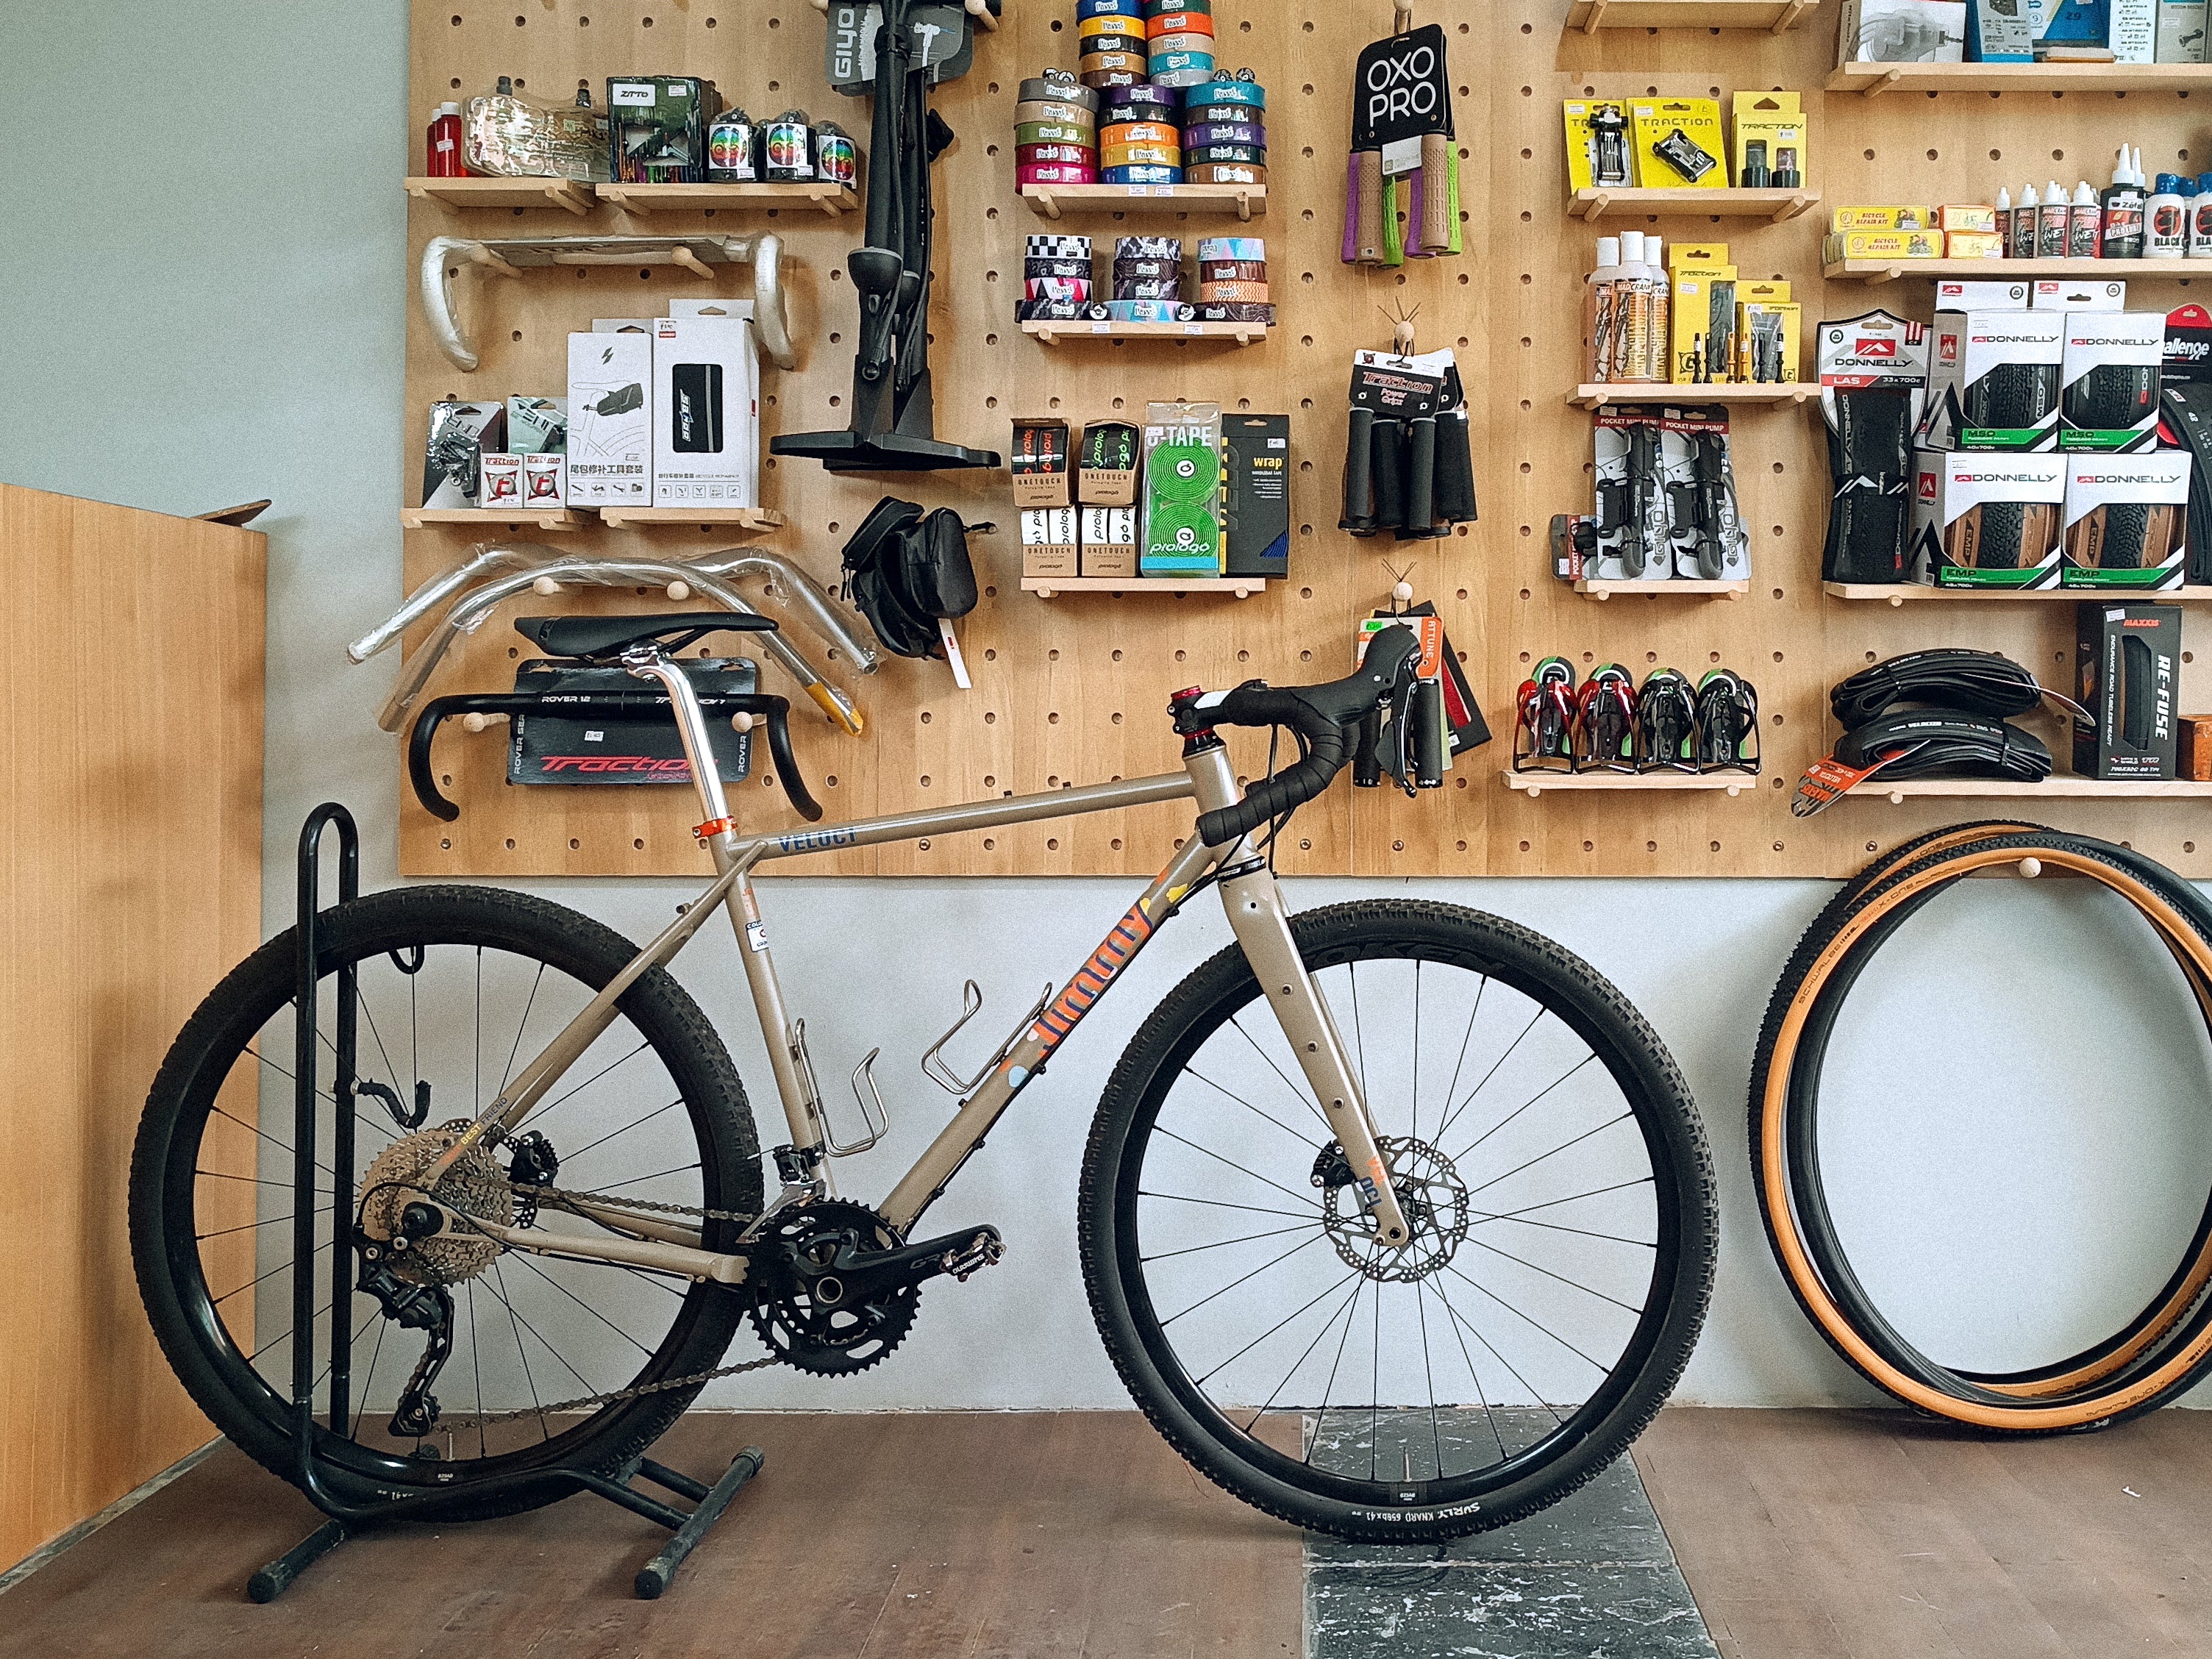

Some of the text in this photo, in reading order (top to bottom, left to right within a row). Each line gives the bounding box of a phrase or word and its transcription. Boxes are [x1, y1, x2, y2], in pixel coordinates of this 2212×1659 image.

[835, 9, 857, 78] GIYO
[1368, 46, 1434, 91] OXO
[1369, 81, 1436, 127] PRO
[1641, 118, 1713, 126] TRACTION
[1835, 358, 1913, 367] DONNELLY
[1363, 371, 1434, 393] Traction
[1833, 377, 1860, 385] LAS
[485, 457, 520, 465] Traction
[1253, 457, 1282, 470] wrap
[1085, 473, 1128, 481] ONETOUCH
[1972, 474, 2058, 482] DONNELLY
[2095, 475, 2181, 483] DONNELLY
[1149, 541, 1210, 554] prologo
[1426, 620, 1436, 658] ATTUNE
[2155, 654, 2171, 740] RE-FUSE
[514, 738, 524, 774] ROVER
[738, 735, 748, 773] ROVER
[540, 756, 718, 771] Tractio
[1798, 943, 1841, 1004] SCHWALBE
[1879, 882, 1913, 908] X-ONE
[1405, 1512, 1434, 1522] KNARD
